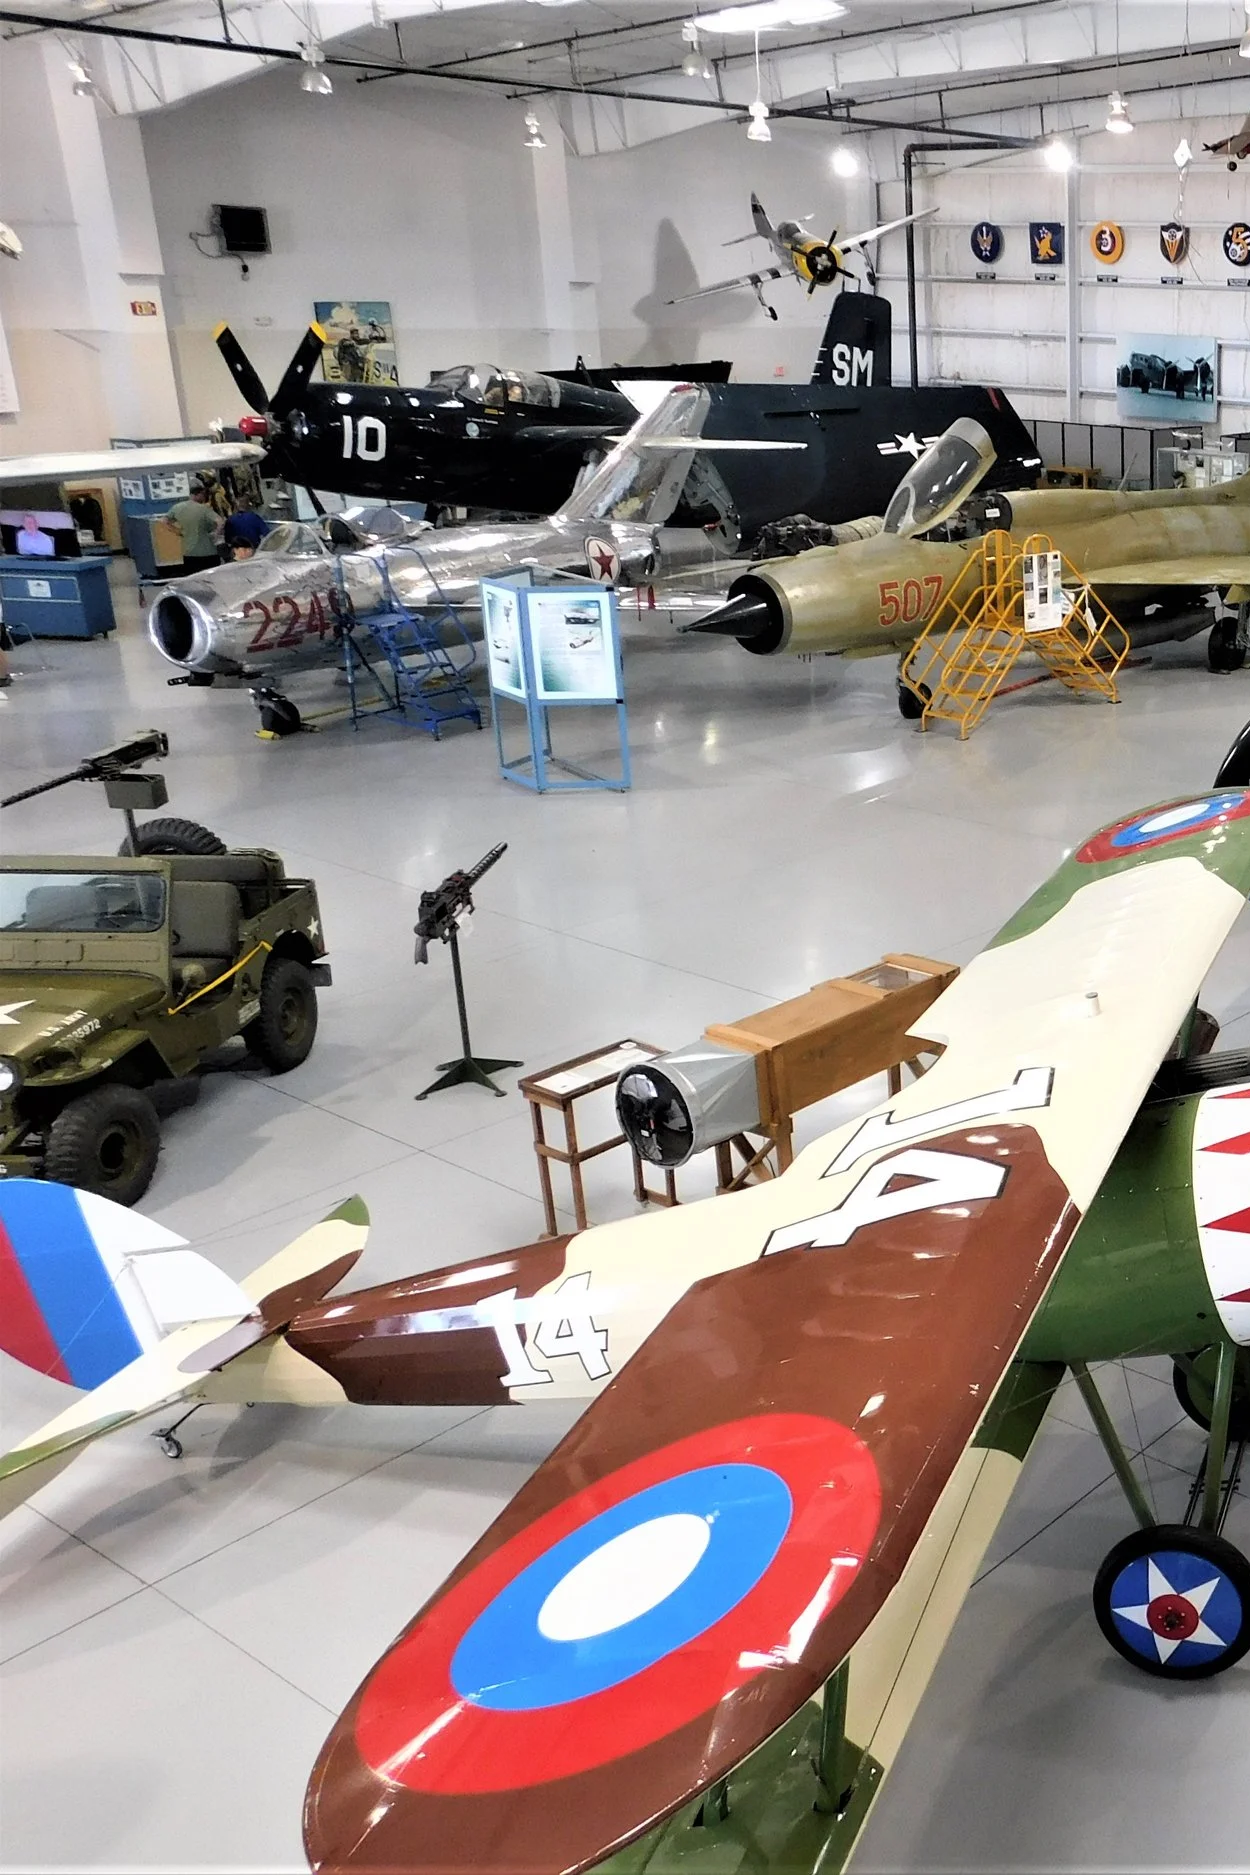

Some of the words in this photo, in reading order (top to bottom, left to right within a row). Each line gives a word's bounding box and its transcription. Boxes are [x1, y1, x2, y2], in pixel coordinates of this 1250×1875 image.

[832, 343, 874, 387] SM
[342, 414, 386, 461] 10
[879, 574, 944, 627] 507
[480, 1270, 612, 1388] 14
